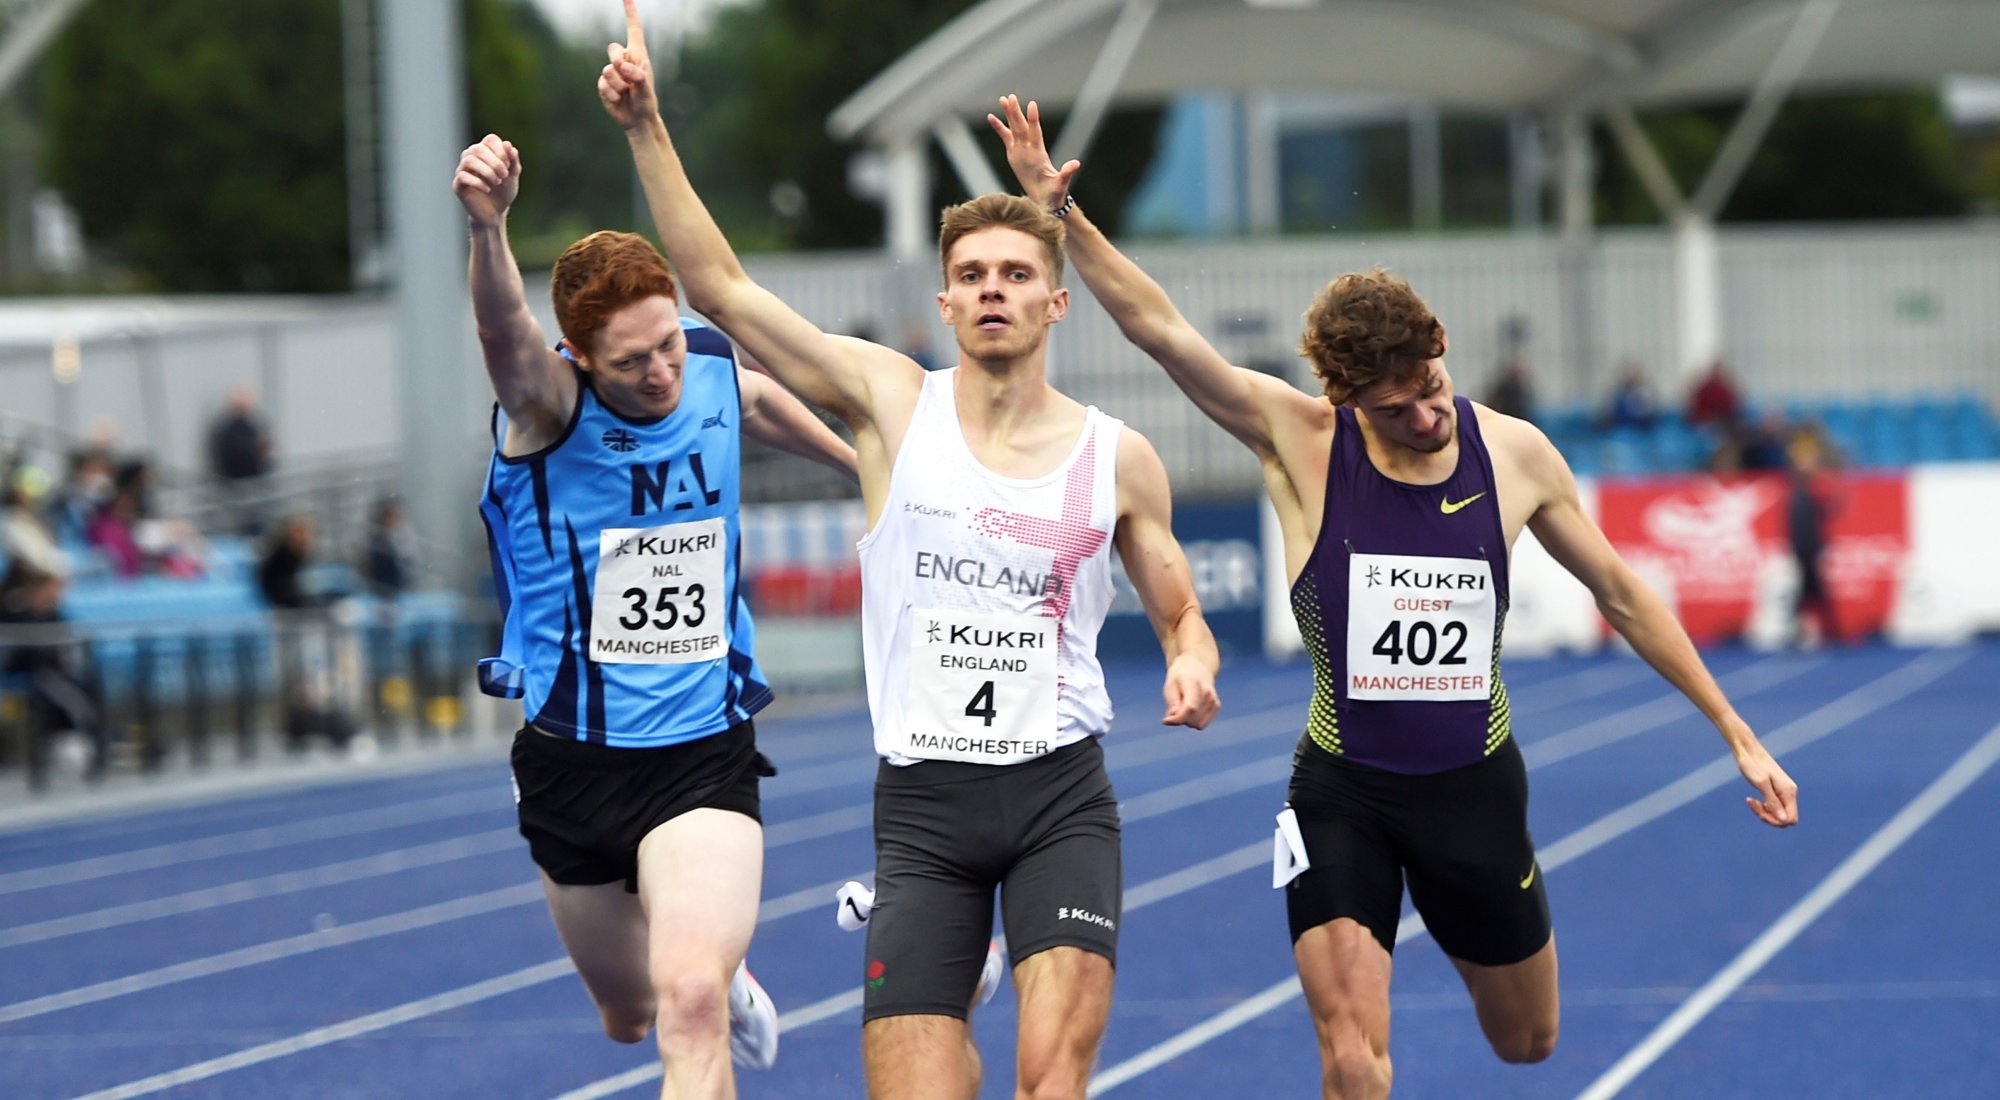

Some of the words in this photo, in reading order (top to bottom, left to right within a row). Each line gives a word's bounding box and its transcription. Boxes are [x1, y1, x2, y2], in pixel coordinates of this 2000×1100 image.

[630, 452, 720, 516] NAL
[913, 503, 957, 520] KUKRI
[637, 533, 717, 555] KUKRI
[652, 564, 683, 578] NAL
[915, 551, 1064, 597] ENGLAND
[1391, 568, 1485, 590] KUKRI
[619, 583, 705, 630] 353
[1394, 598, 1453, 611] GUEST
[597, 635, 720, 654] MANCHESTER
[950, 625, 1044, 648] KUKRI
[1372, 620, 1468, 666] 402
[940, 655, 1027, 672] ENGLAND
[1353, 675, 1484, 690] MANCHESTER
[965, 681, 997, 726] 4
[910, 733, 1049, 754] MANCHESTER
